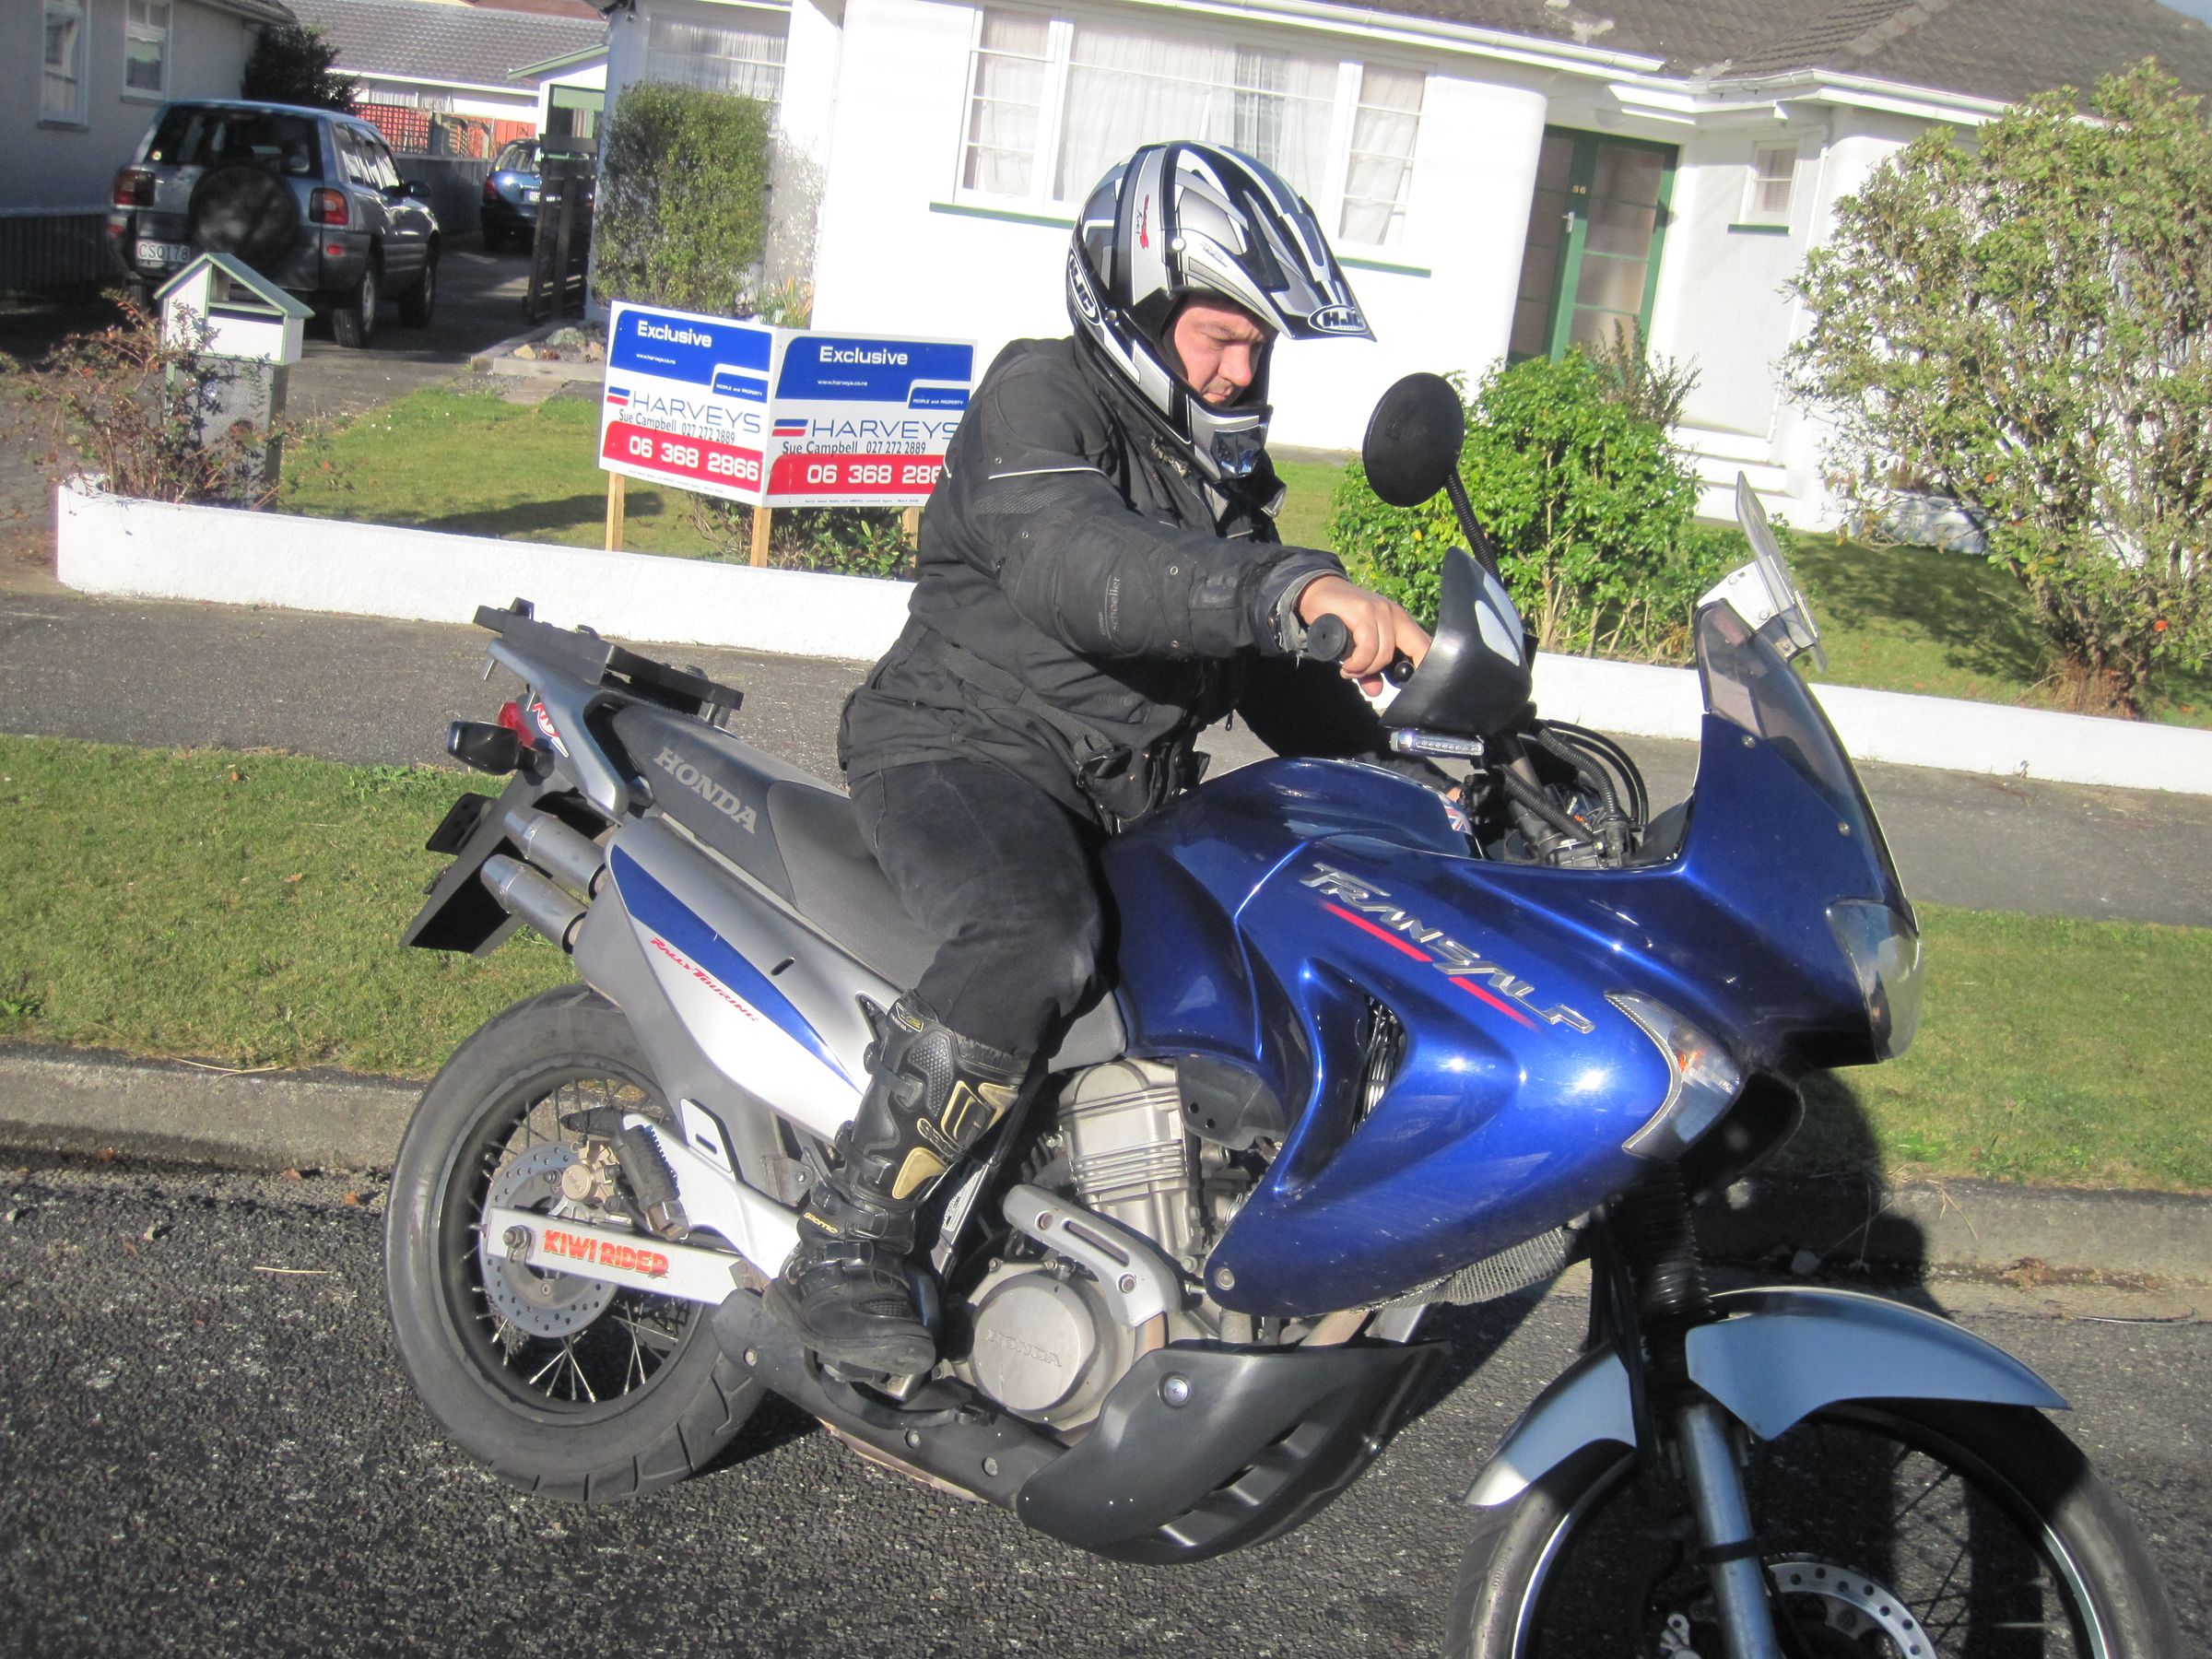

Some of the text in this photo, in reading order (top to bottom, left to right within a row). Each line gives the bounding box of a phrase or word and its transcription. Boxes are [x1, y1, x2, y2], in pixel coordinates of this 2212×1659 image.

[637, 320, 712, 347] Exclusive
[819, 345, 909, 365] Exclusive
[618, 408, 735, 444] Sue Campbell 027 272 2889
[632, 391, 761, 434] HARVEYS
[812, 419, 960, 440] HARVEYS
[629, 435, 653, 459] 06
[660, 442, 700, 468] 368
[707, 452, 759, 481] 2866
[782, 441, 926, 457] Sue Campbell 027 272 2889
[806, 465, 838, 484] 06
[847, 465, 892, 485] 368
[653, 747, 757, 834] HONDA
[1299, 862, 1595, 1033] TRANSALP
[543, 1229, 670, 1278] KIWI RIDER
[985, 1327, 1062, 1368] HONDA
